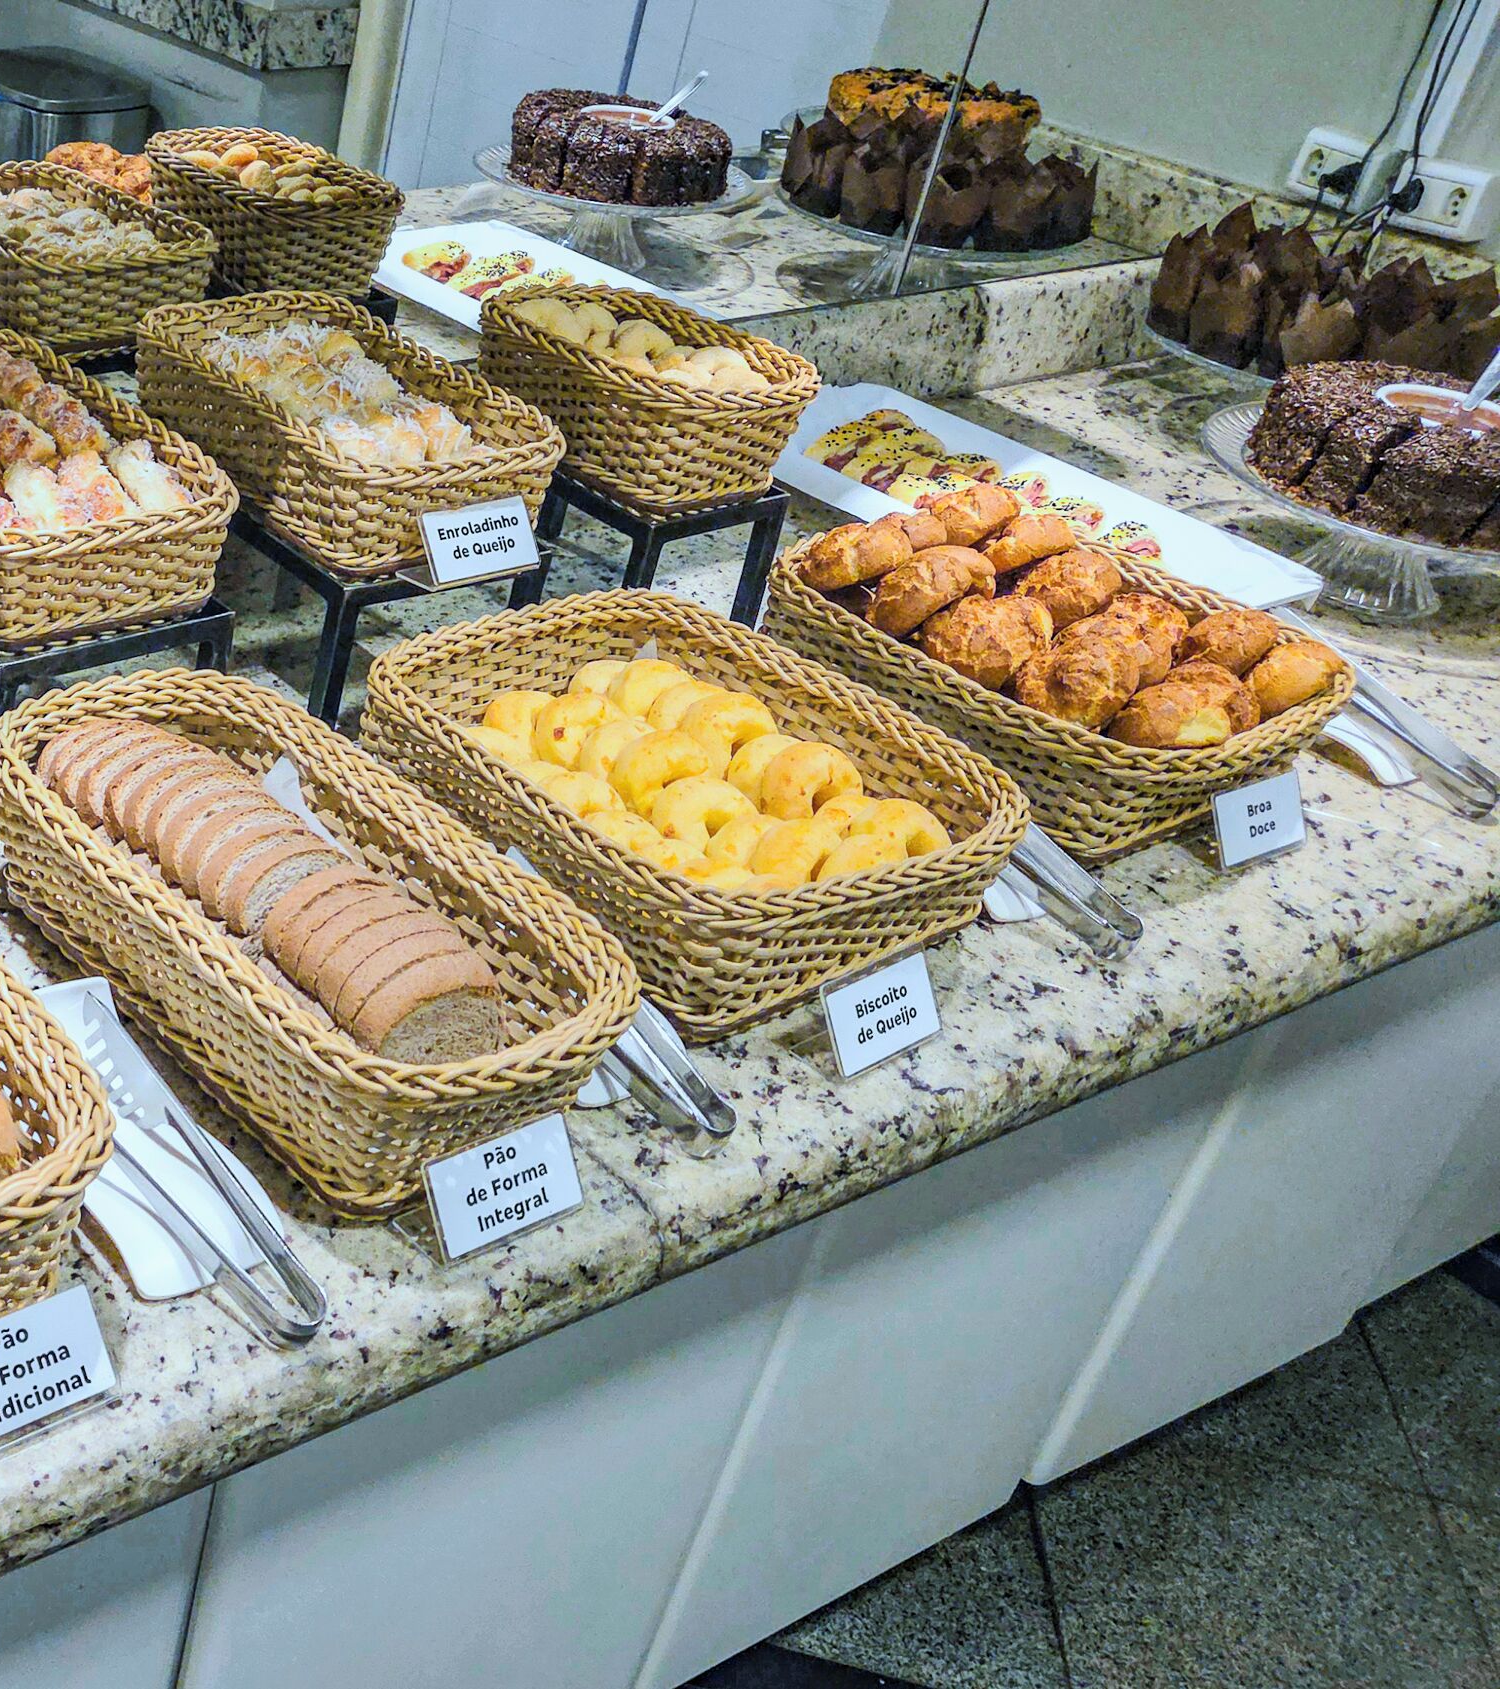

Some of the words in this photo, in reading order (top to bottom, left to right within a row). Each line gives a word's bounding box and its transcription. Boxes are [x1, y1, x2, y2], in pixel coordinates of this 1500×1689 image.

[437, 514, 520, 541] Enroladinho
[453, 546, 470, 560] de
[472, 537, 516, 559] Queijo
[1246, 800, 1272, 818] Broa
[1249, 820, 1276, 838] Doce
[854, 986, 908, 1019] Biscoito
[857, 1028, 874, 1045] de
[876, 1006, 918, 1035] Queijo
[483, 1142, 517, 1170] Pão
[466, 1187, 488, 1207] de
[491, 1162, 548, 1197] Forma
[477, 1186, 550, 1233] Integral
